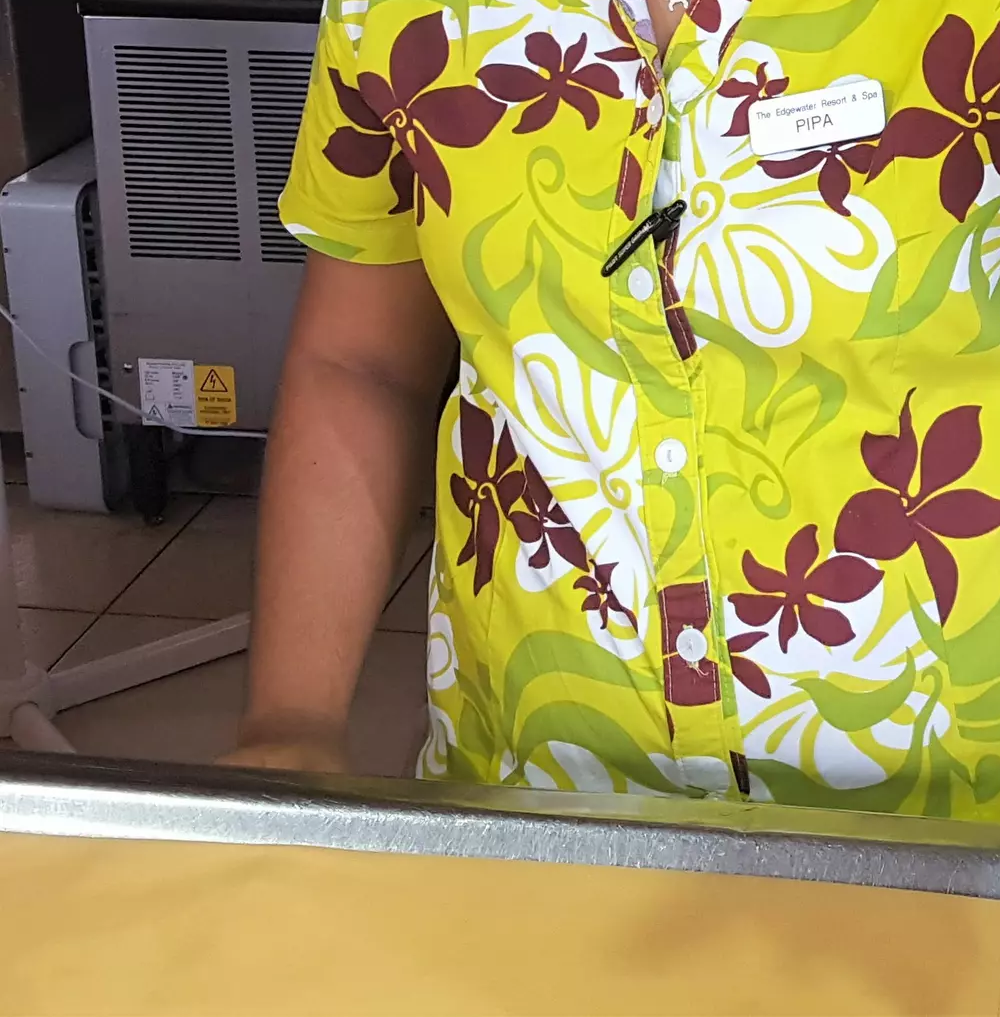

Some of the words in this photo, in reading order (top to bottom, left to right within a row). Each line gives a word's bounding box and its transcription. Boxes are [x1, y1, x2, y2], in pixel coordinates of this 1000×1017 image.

[756, 111, 771, 120] The
[776, 102, 817, 117] Edgewater
[821, 96, 848, 108] Resort
[851, 94, 857, 102] &
[862, 90, 878, 101] Spa
[796, 113, 834, 132] PIPA
